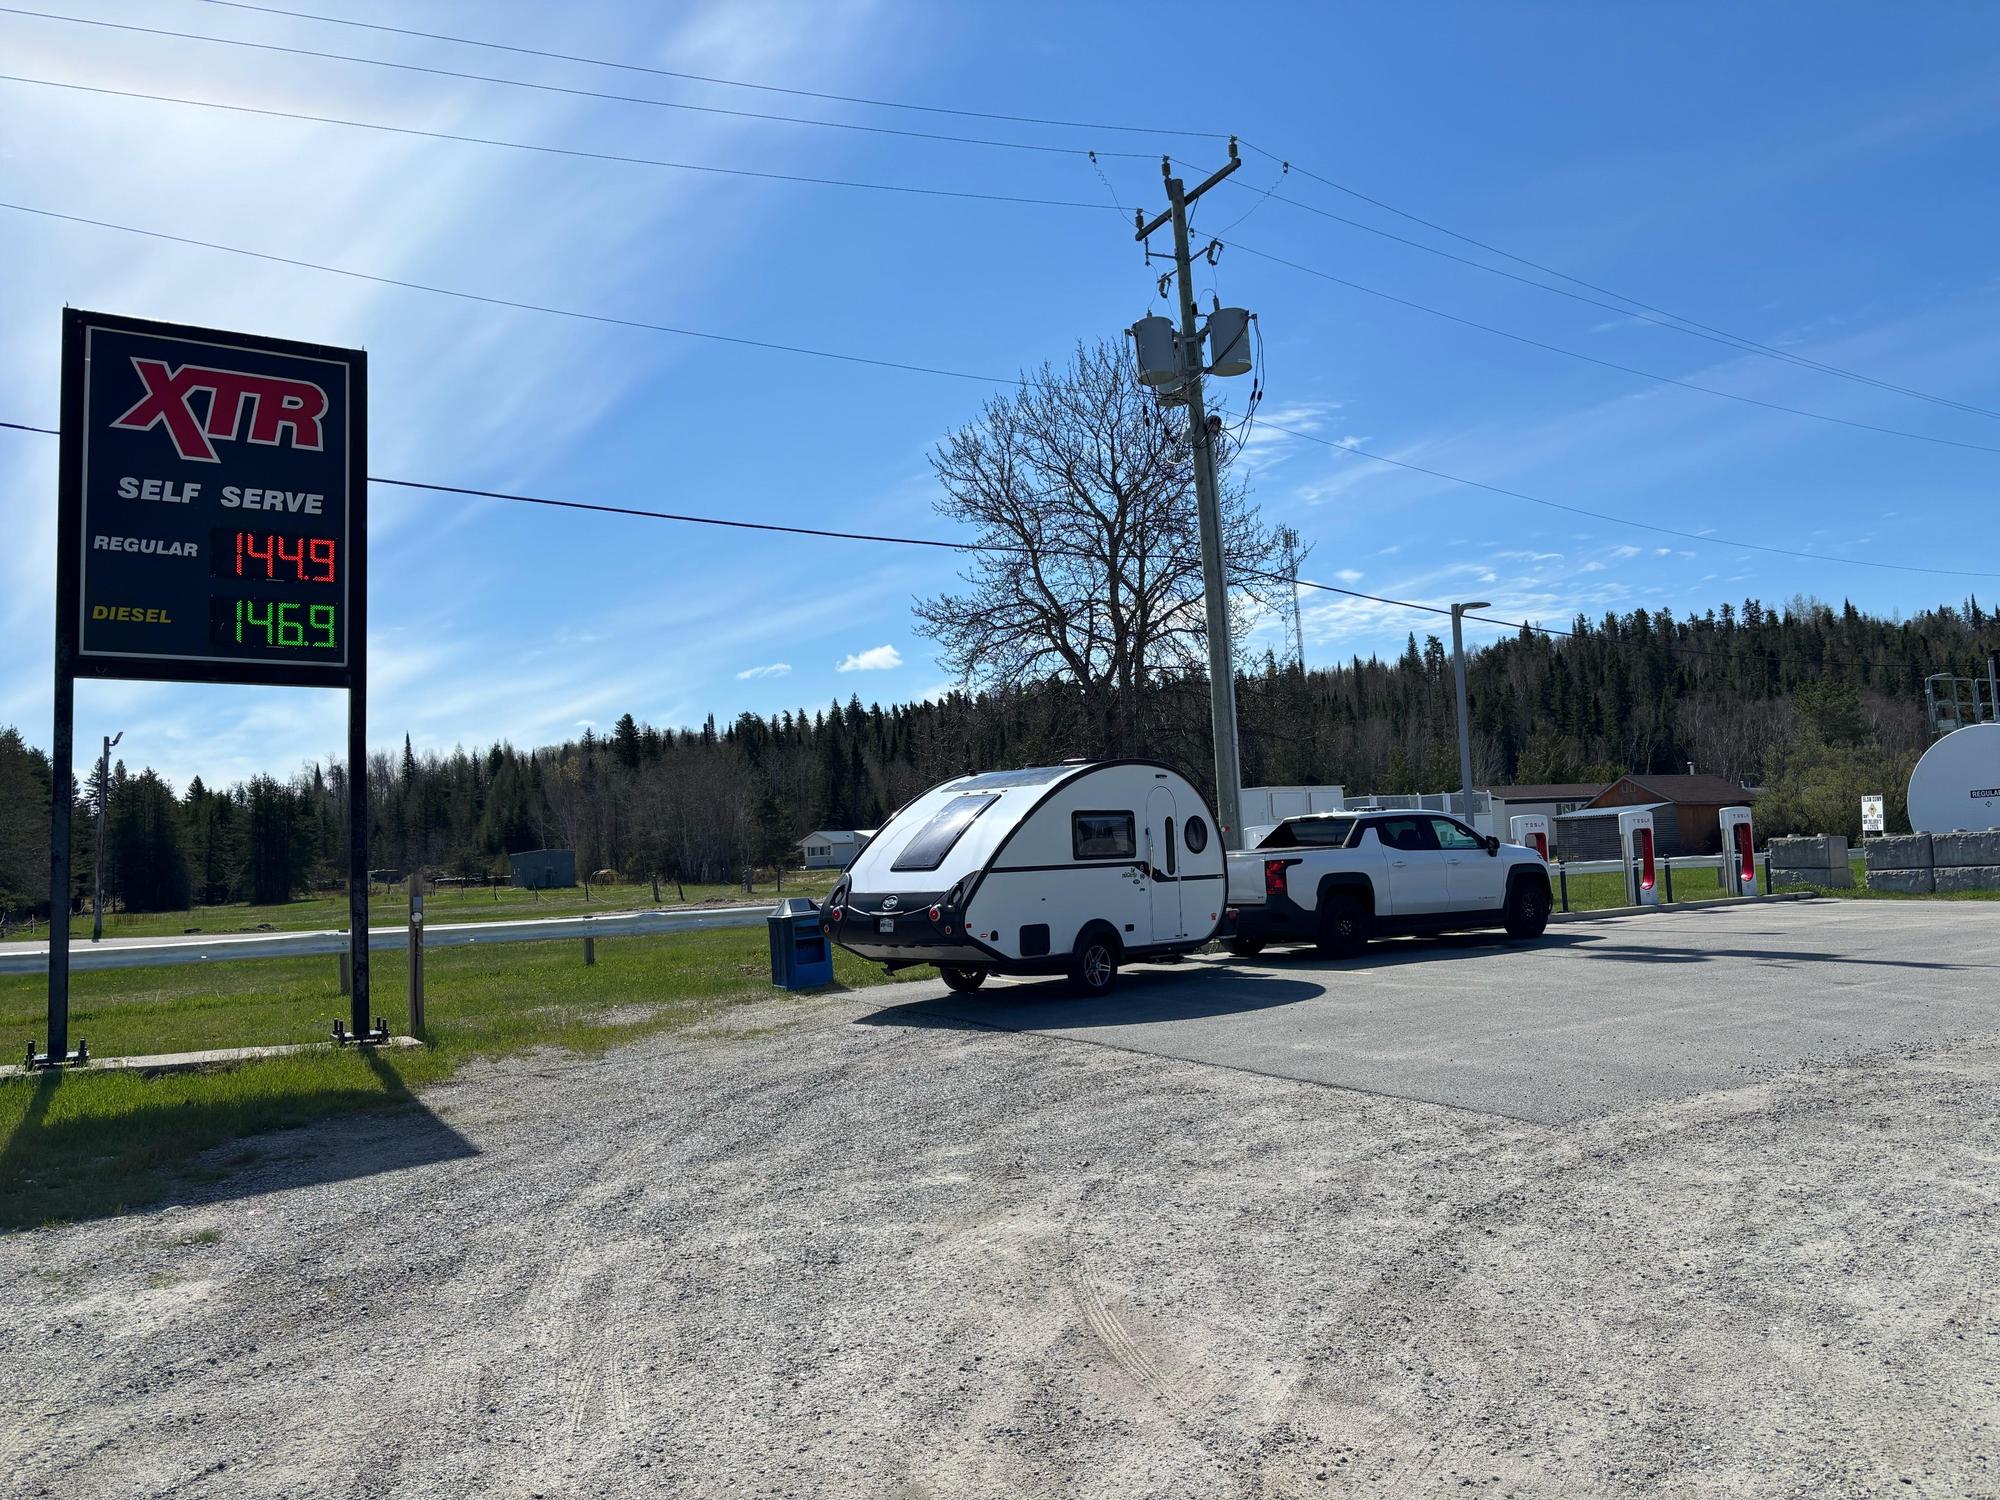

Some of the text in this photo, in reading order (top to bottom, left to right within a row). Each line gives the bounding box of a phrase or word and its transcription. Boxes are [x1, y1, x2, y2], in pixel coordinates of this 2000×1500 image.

[109, 356, 329, 464] XTR
[117, 476, 324, 515] SELF SERVE
[93, 532, 335, 583] REGULAR 144.9
[92, 600, 335, 648] DIESEL 146.9
